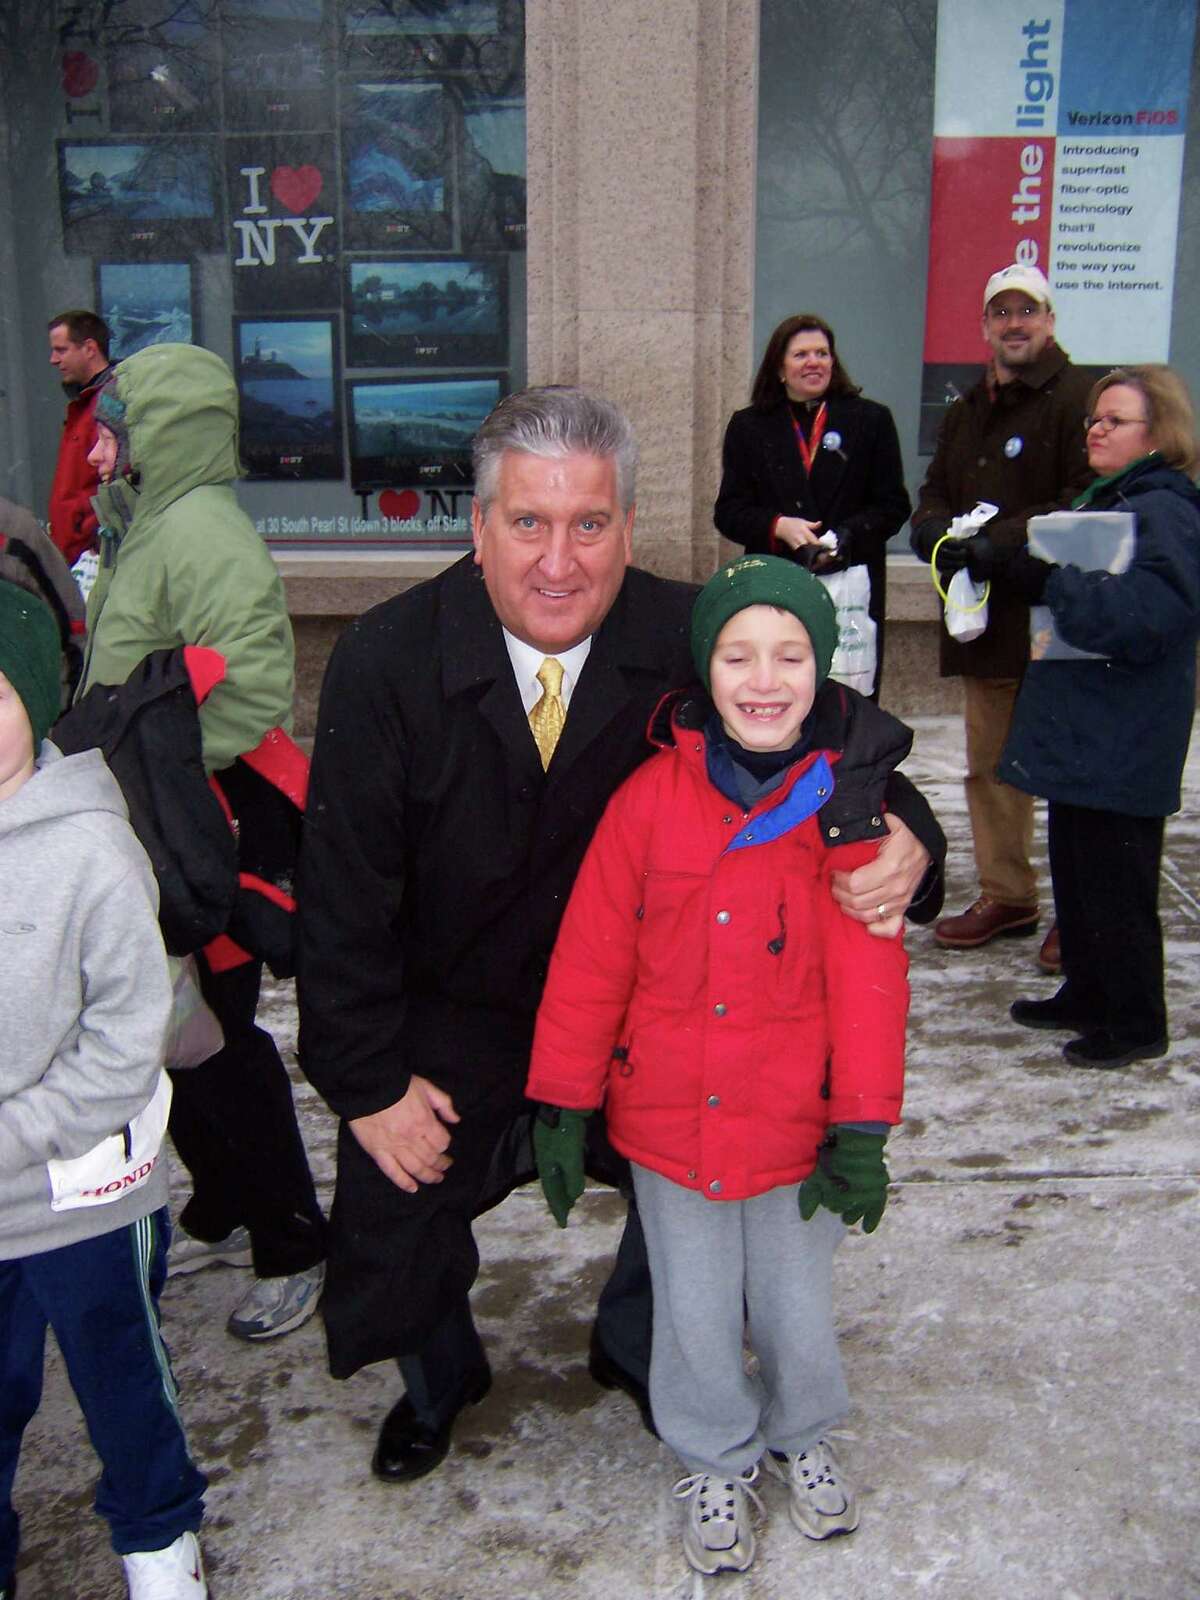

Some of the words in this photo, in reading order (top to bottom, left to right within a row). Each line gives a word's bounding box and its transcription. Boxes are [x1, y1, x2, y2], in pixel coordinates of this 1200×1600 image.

[1016, 18, 1054, 128] light
[1067, 111, 1133, 125] Verizon
[1062, 145, 1139, 157] Introducing
[1061, 165, 1126, 177] superfast
[240, 167, 268, 214] I
[1011, 144, 1044, 226] the
[1060, 184, 1129, 195] fiber-optic
[1059, 203, 1133, 216] technology
[1058, 223, 1095, 233] that'll
[1057, 241, 1141, 252] revolutionize
[1056, 260, 1077, 270] the
[1081, 263, 1108, 273] way
[1112, 263, 1135, 273] you
[1055, 281, 1079, 290] use
[1083, 280, 1104, 290] the
[267, 516, 279, 533] 30
[281, 515, 309, 533] South
[311, 515, 336, 533] Pearl
[382, 516, 389, 533] 3
[427, 515, 441, 533] off
[443, 515, 468, 533] State
